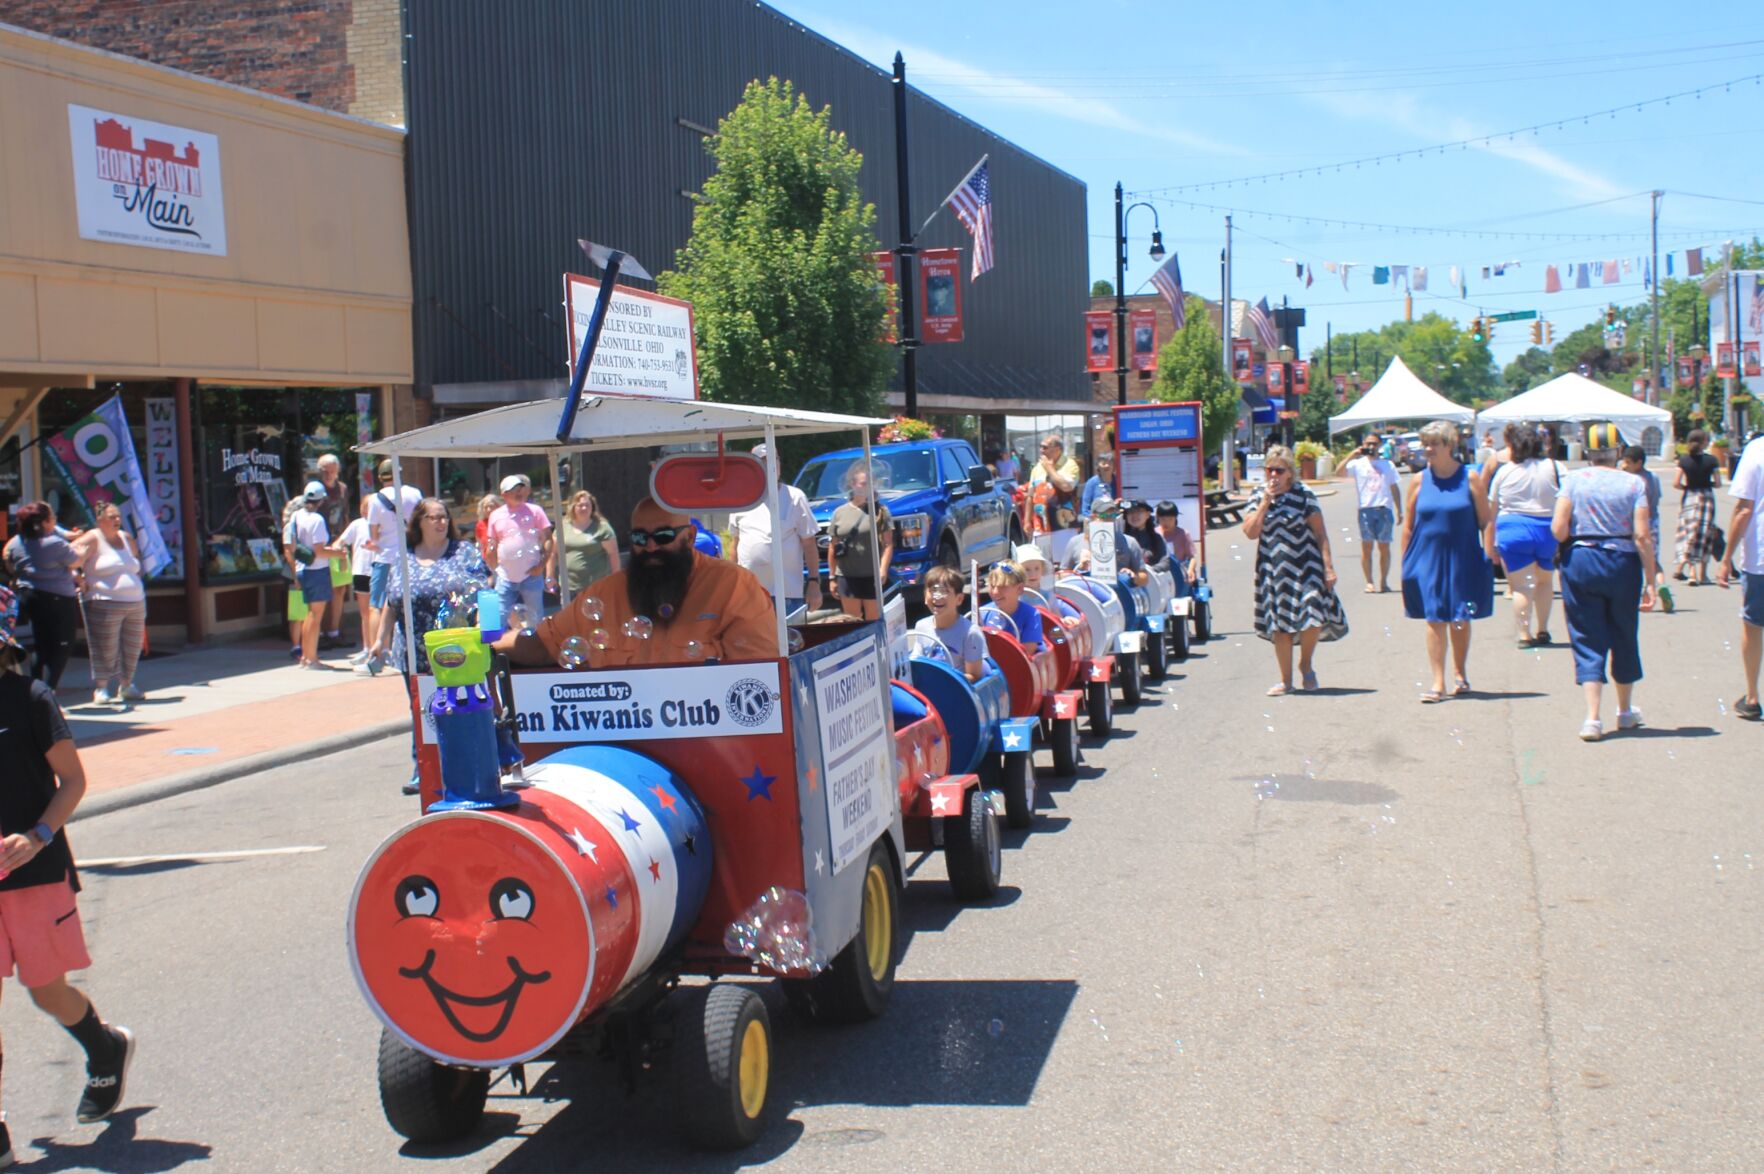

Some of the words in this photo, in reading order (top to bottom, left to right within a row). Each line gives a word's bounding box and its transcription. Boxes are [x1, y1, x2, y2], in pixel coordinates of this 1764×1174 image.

[96, 145, 142, 183] HOME
[144, 157, 201, 196] GROWN
[124, 177, 199, 236] Main
[643, 307, 653, 318] BY
[628, 322, 656, 337] SCENIC
[657, 326, 686, 340] RAILWAY
[645, 341, 664, 353] OHIO
[222, 448, 250, 472] Home
[250, 448, 281, 470] Grown
[248, 465, 273, 484] Main
[552, 684, 607, 701] Donated
[609, 684, 630, 701] by:
[824, 661, 876, 714] WASHBOARD
[550, 702, 654, 733] Kiwanis
[659, 698, 720, 728] Club
[828, 713, 853, 753] MUSIC
[853, 696, 880, 739] FESTIVAL
[833, 763, 865, 807] FATHER'S
[864, 755, 875, 783] DAY
[842, 788, 872, 831] WEEKEND
